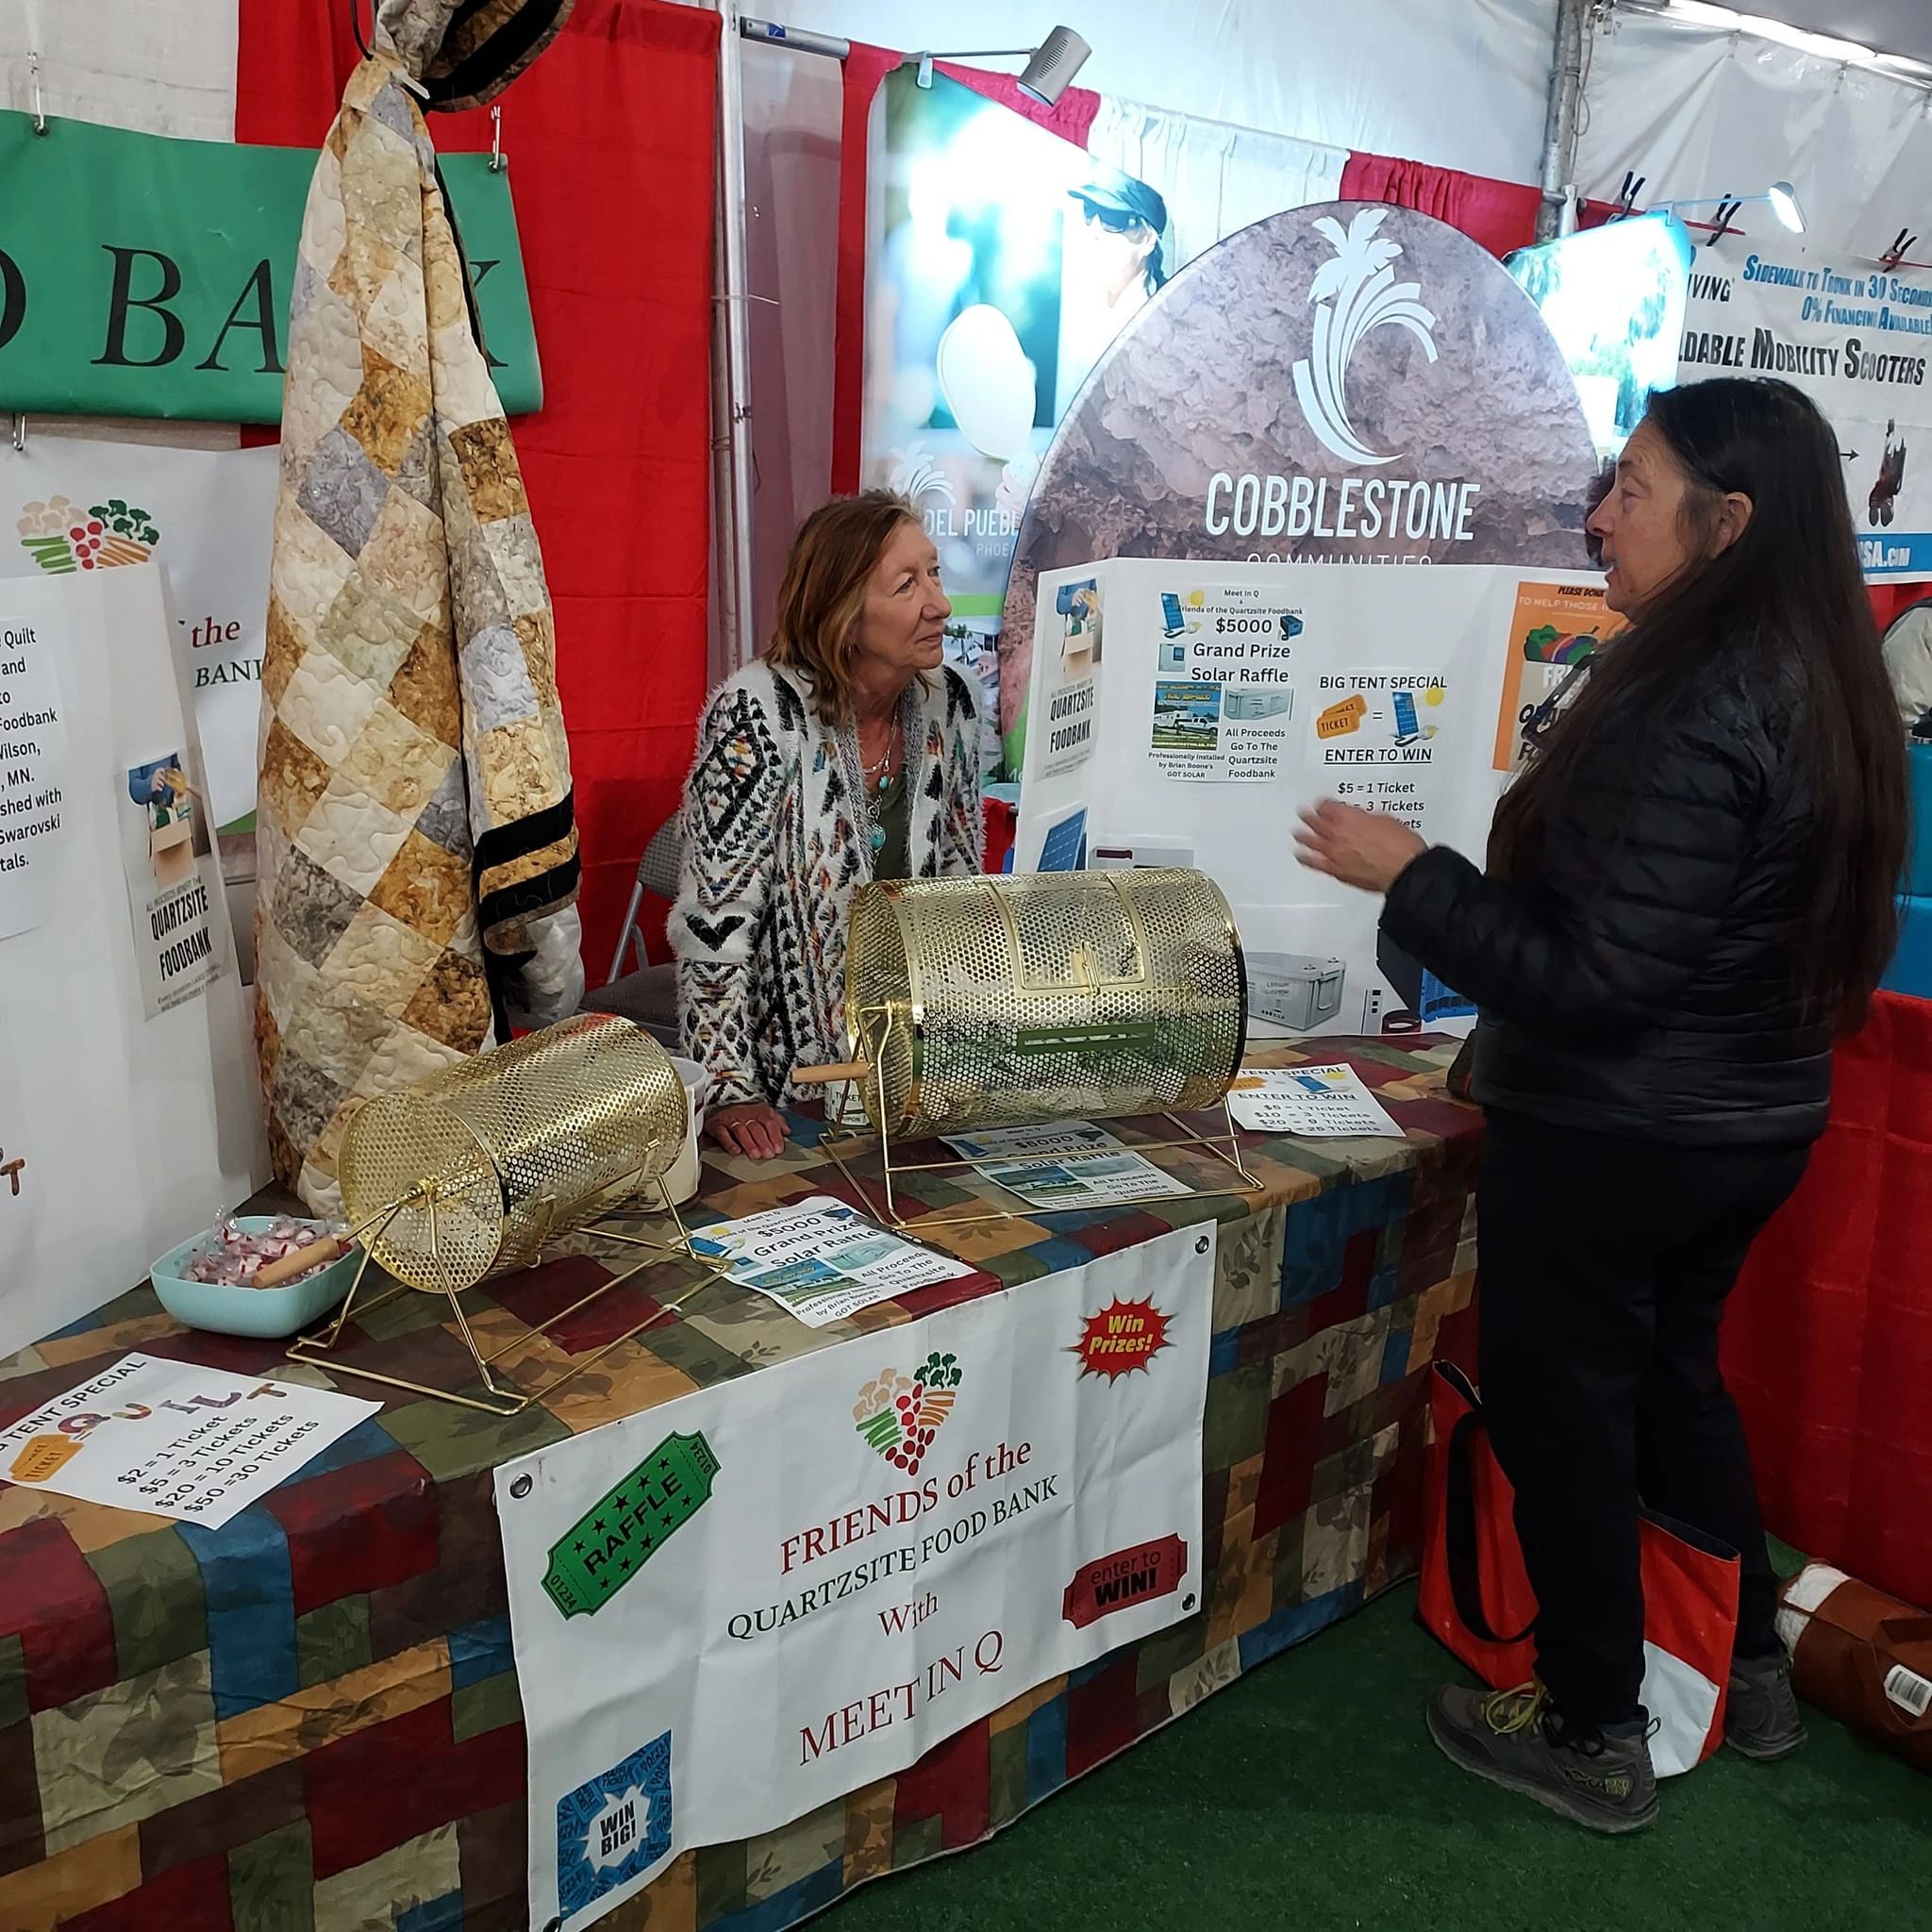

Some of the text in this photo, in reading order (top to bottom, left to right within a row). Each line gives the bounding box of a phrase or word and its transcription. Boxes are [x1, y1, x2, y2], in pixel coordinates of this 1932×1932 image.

[1868, 275, 1887, 299] 30
[1678, 331, 1745, 368] DABLE
[1206, 473, 1481, 541] COBBLESTONE
[976, 542, 1015, 557] PHOE
[1224, 589, 1243, 597] Meet
[4, 627, 37, 649] Quilt
[191, 616, 242, 648] the
[1215, 617, 1273, 635] $5000
[1193, 642, 1291, 658] Grand Prize
[1, 657, 26, 675] and
[1191, 667, 1289, 683] Solar Raffle
[1320, 676, 1448, 689] BIG TENT SPECIAL
[1050, 686, 1094, 722] QUARTZSITE
[1050, 719, 1091, 754] FOODBANK
[1225, 727, 1286, 738] All Proceeds
[1321, 717, 1350, 733] TICKET
[0, 741, 41, 760] ilson,
[1228, 755, 1277, 766] Quartzsite
[1230, 741, 1278, 752] Go To The
[1324, 748, 1432, 761] ENTER TO WIN
[8, 767, 35, 787] MN.
[1183, 771, 1206, 779] SOLAR
[1228, 769, 1275, 779] Foodbank
[1338, 781, 1354, 794] $5
[1377, 781, 1415, 793] Ticket
[36, 787, 61, 808] with
[1380, 800, 1424, 811] Tickets
[0, 813, 60, 845] Swarovski
[151, 885, 209, 941] QUARTZSITE
[158, 926, 213, 982] FOODBANK
[1281, 1066, 1347, 1076] SPECIAL
[1019, 1158, 1066, 1170] Solar
[754, 1233, 813, 1257] Grand
[816, 1220, 862, 1239] Prize
[758, 1217, 822, 1238] $5000
[771, 1244, 822, 1268] Solar
[824, 1229, 881, 1249] Raffle
[1108, 1314, 1144, 1334] Win
[1089, 1334, 1153, 1356] Prizes!
[2, 1360, 147, 1441] TENT SPECIAL
[58, 1383, 287, 1433] QUILT
[118, 1468, 148, 1485] $2
[168, 1415, 229, 1450] Ticket
[139, 1477, 169, 1494] $5
[191, 1417, 258, 1458] Tickets
[155, 1414, 294, 1507] $20 10 Tickets
[690, 1441, 712, 1474] 01234
[25, 1452, 64, 1478] TICKET
[184, 1488, 225, 1512] $50
[254, 1421, 320, 1462] Tickets
[780, 1441, 1032, 1575] FRIENDS of the
[583, 1472, 683, 1575] RAFFLE
[727, 1474, 1060, 1641] QUARTZSITE FOOD BANK
[1091, 1547, 1161, 1585] enter to
[551, 1574, 578, 1609] 01234
[1093, 1568, 1158, 1608] WIN!
[877, 1592, 939, 1637] With
[799, 1630, 1005, 1767] MEET IN Q
[600, 1799, 635, 1838] WIN
[601, 1818, 636, 1857] BIG!
